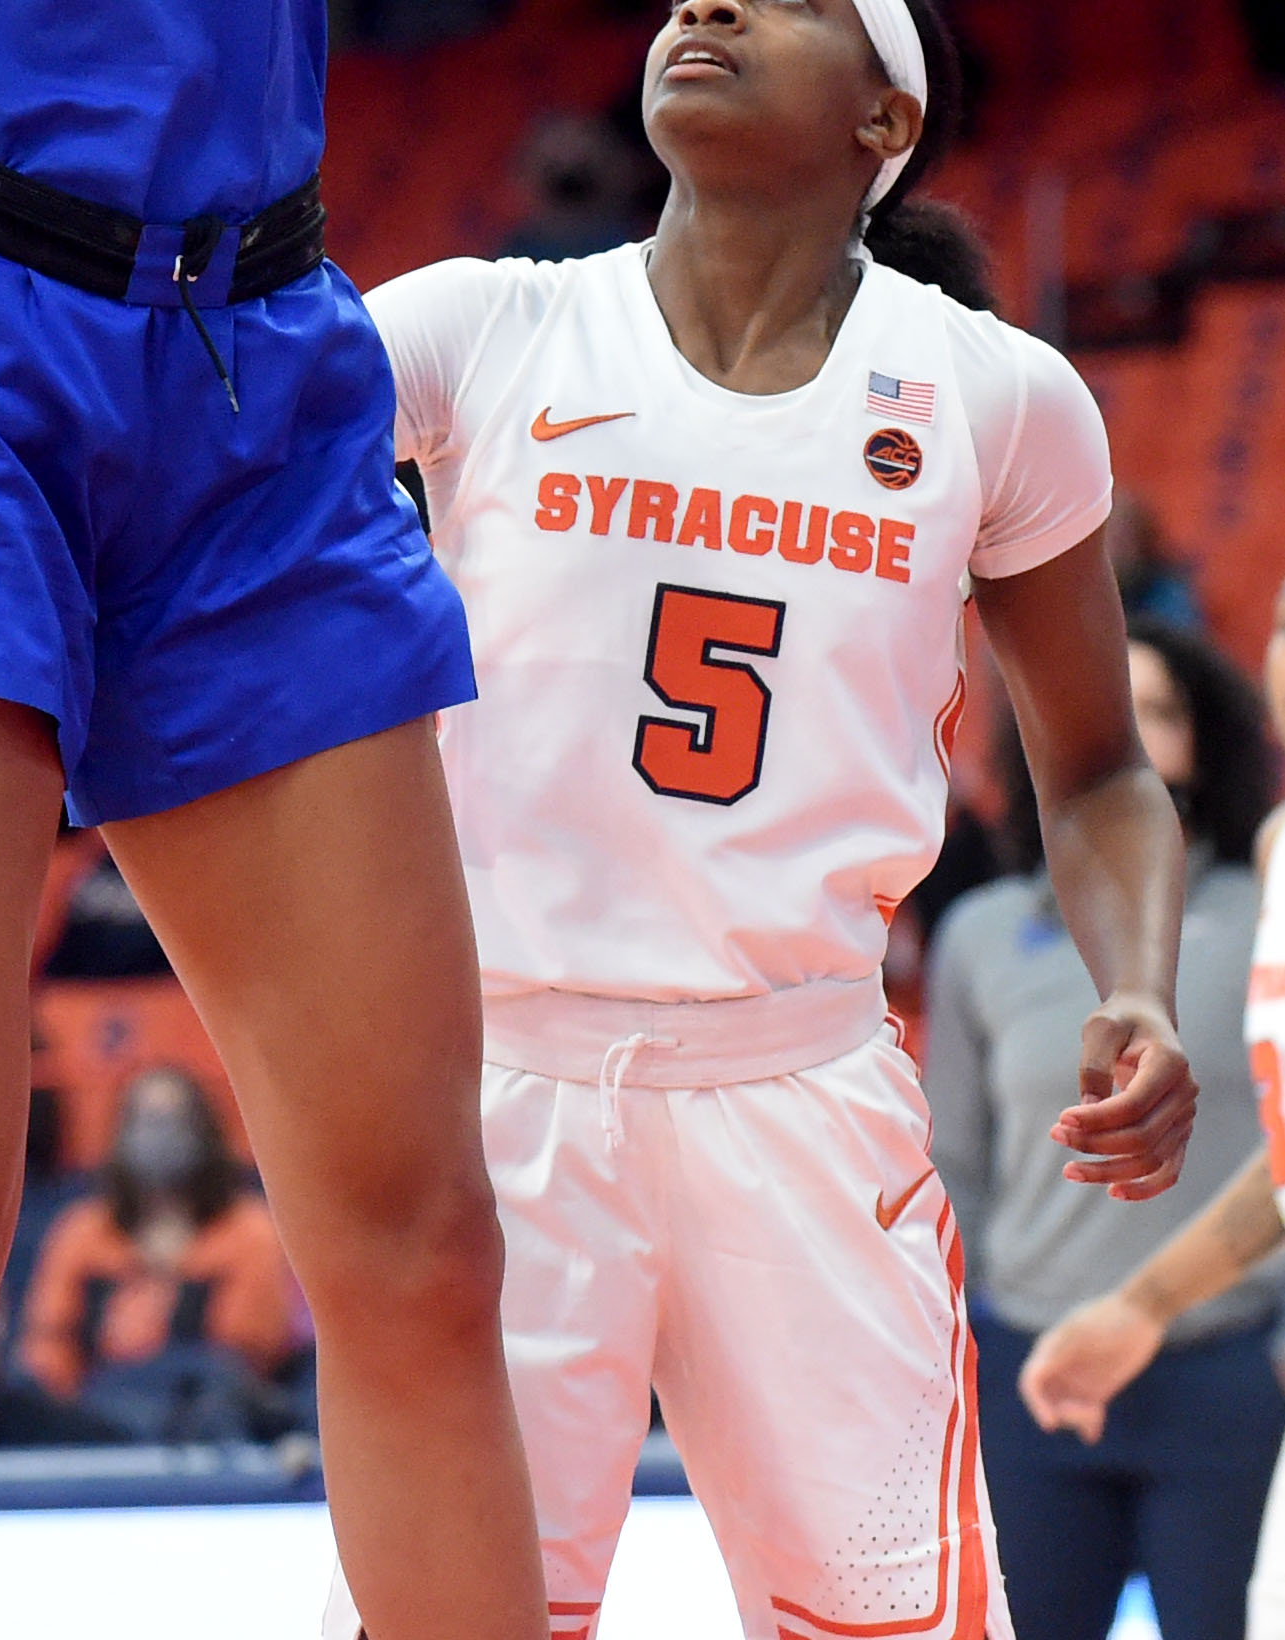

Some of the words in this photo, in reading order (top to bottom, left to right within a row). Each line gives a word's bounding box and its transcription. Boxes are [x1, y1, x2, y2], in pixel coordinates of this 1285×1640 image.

[872, 446, 920, 467] ACC
[535, 472, 916, 583] SYRACUSE
[632, 582, 786, 806] 5
